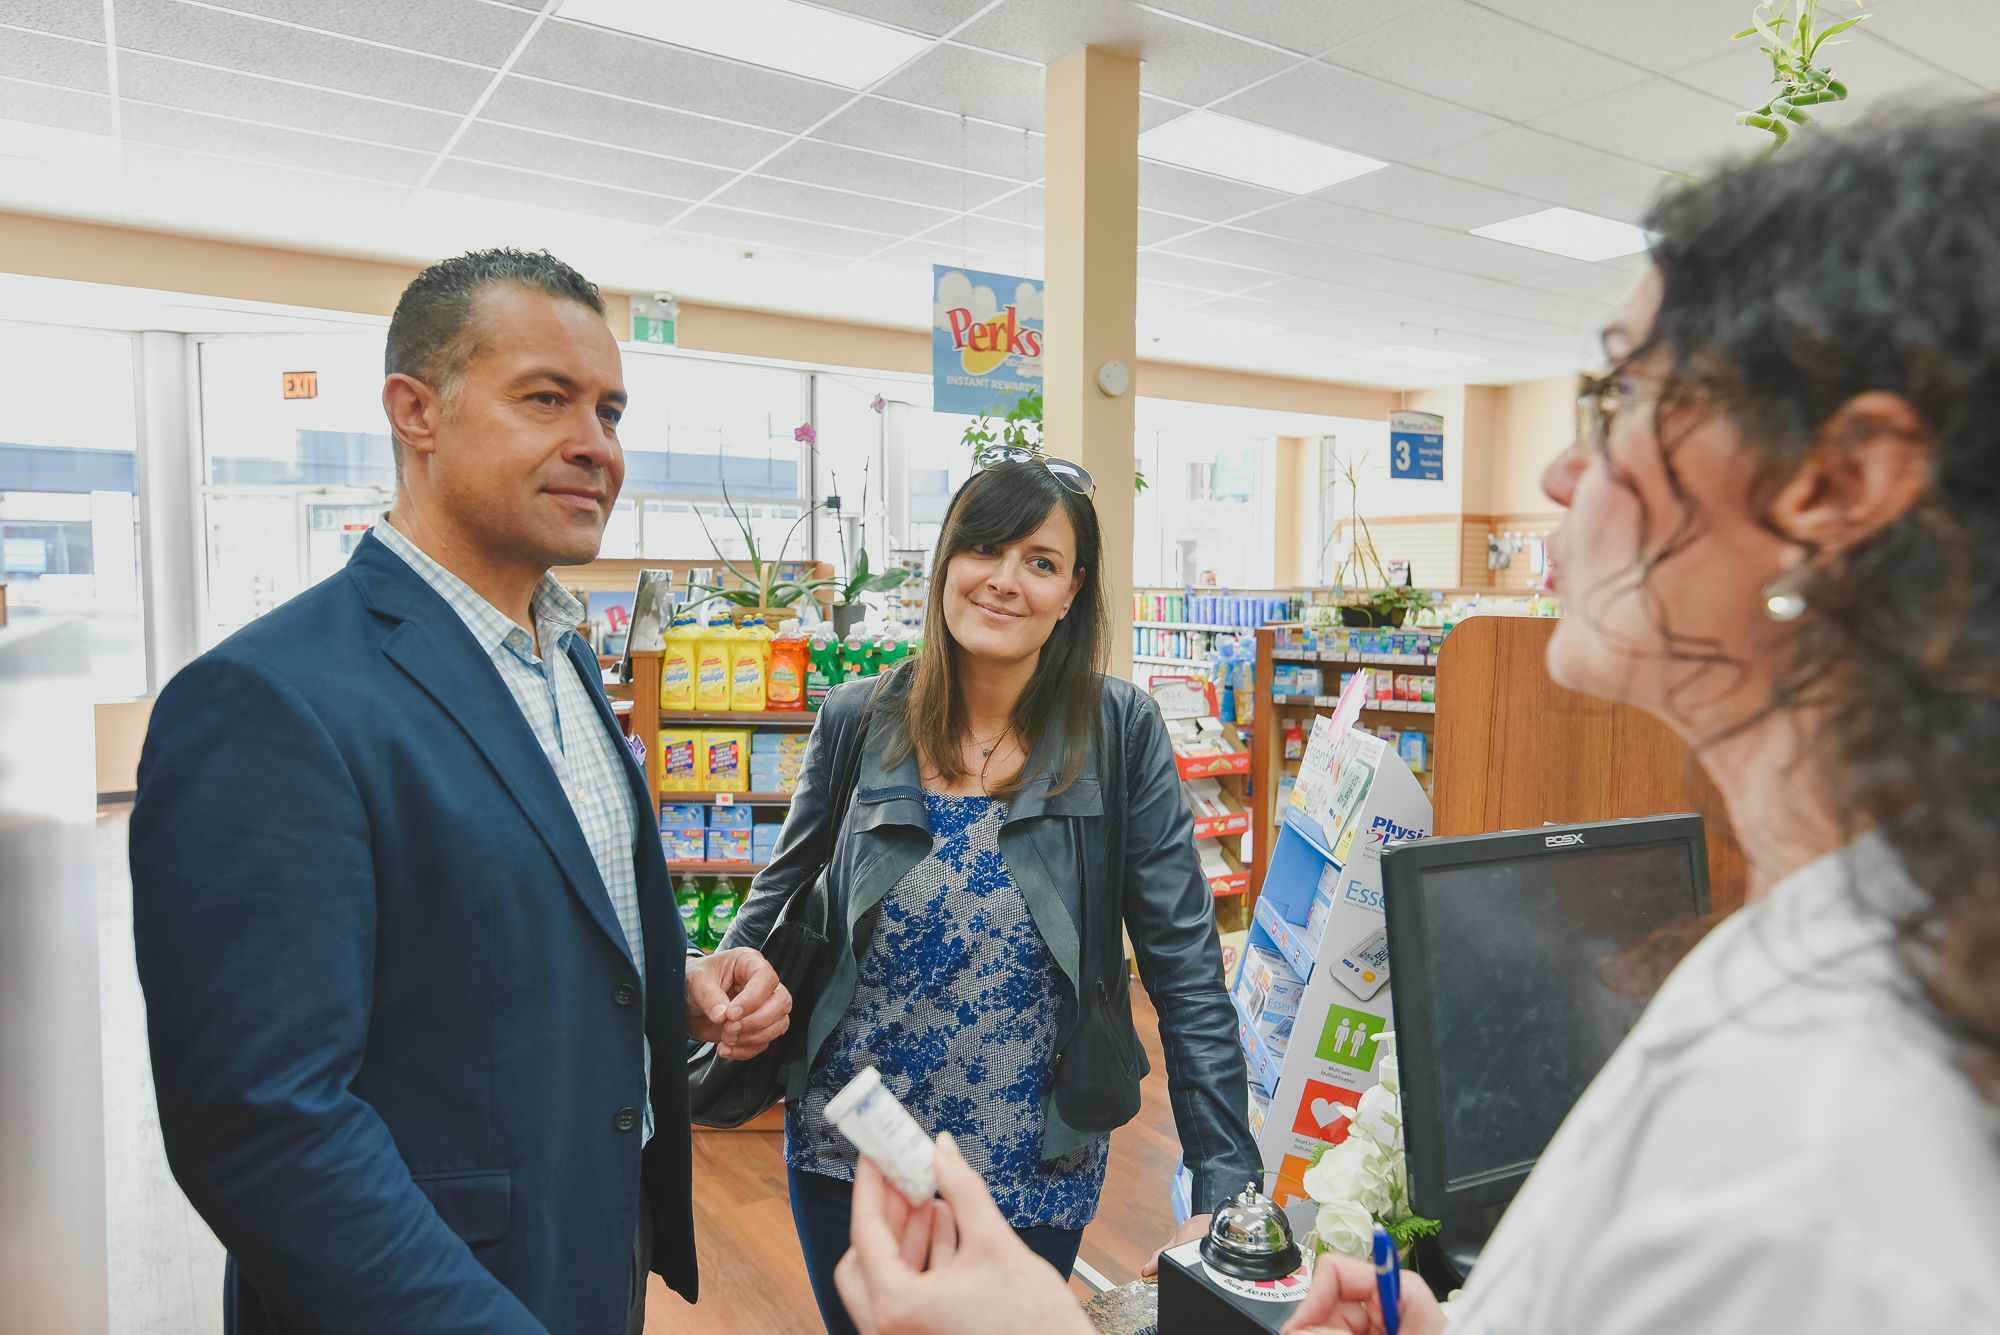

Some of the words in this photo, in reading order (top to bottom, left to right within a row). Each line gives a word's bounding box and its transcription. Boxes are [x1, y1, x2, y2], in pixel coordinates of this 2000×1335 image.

[946, 305, 1042, 358] Perks
[947, 376, 990, 389] INSTANT
[1395, 439, 1411, 472] 3
[1245, 1287, 1280, 1300] Spray
